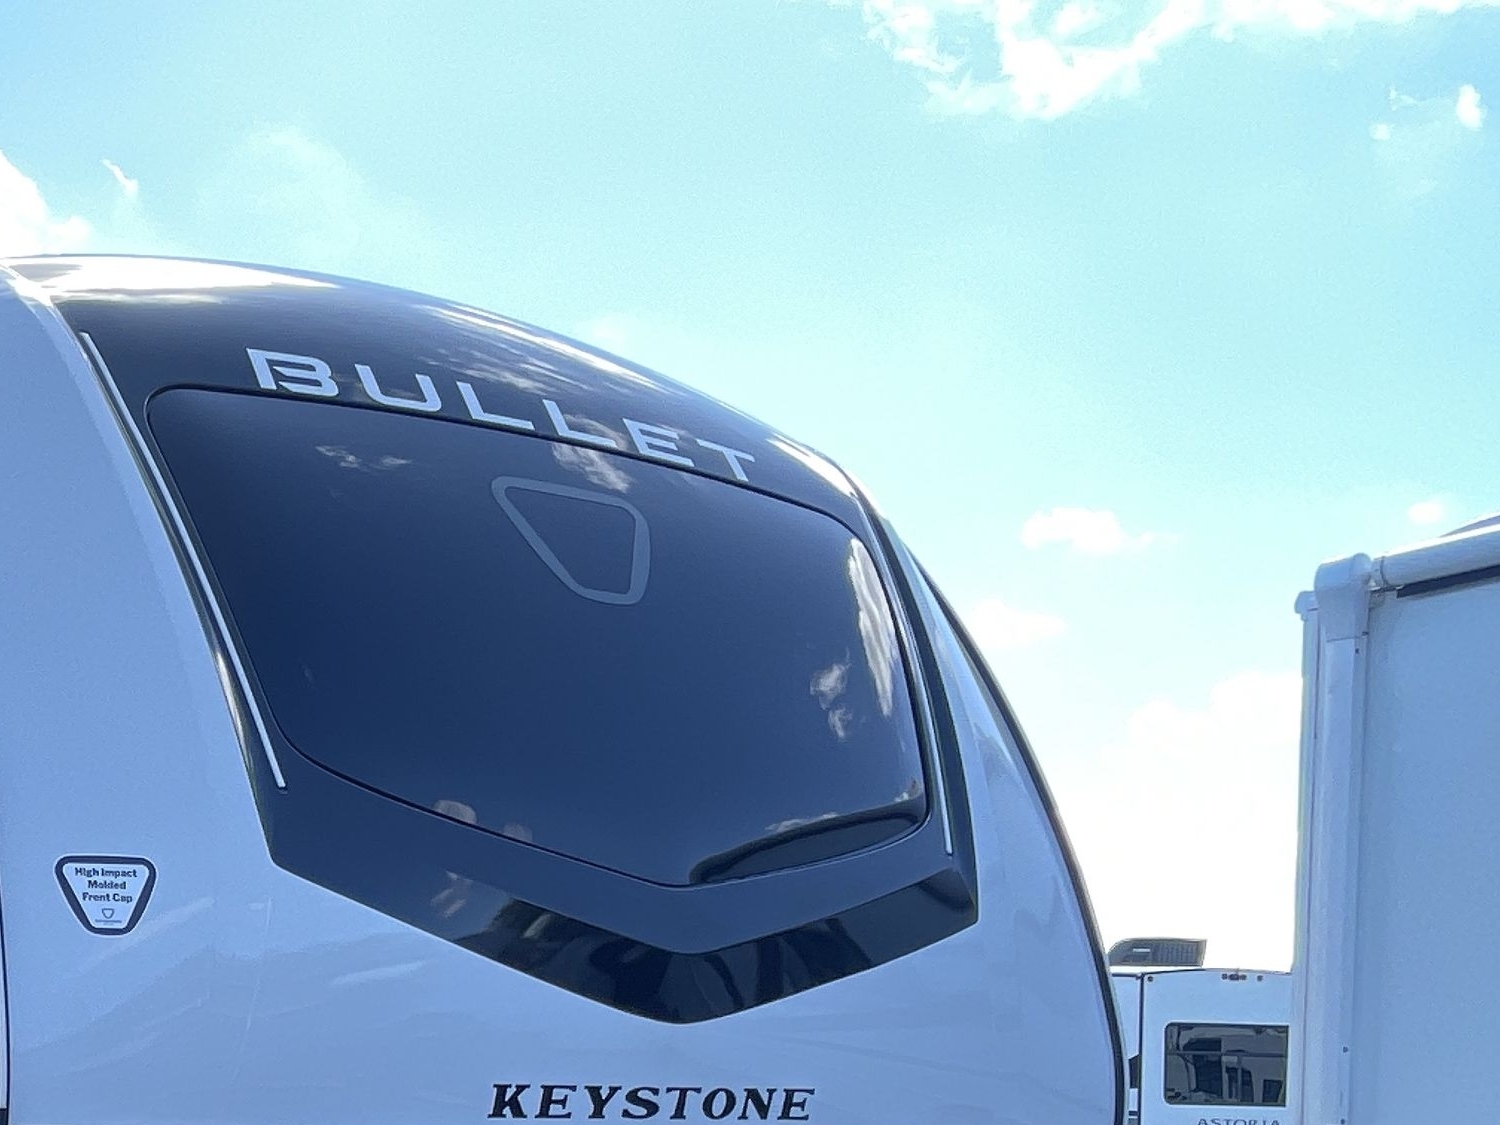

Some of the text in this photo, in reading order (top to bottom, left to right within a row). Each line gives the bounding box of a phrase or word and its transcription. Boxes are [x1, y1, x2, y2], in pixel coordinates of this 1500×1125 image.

[245, 347, 756, 483] BULLET
[74, 867, 138, 878] High Impact
[87, 880, 127, 890] Molded
[82, 892, 133, 904] Front Cap
[487, 1083, 816, 1121] KEYSTONE
